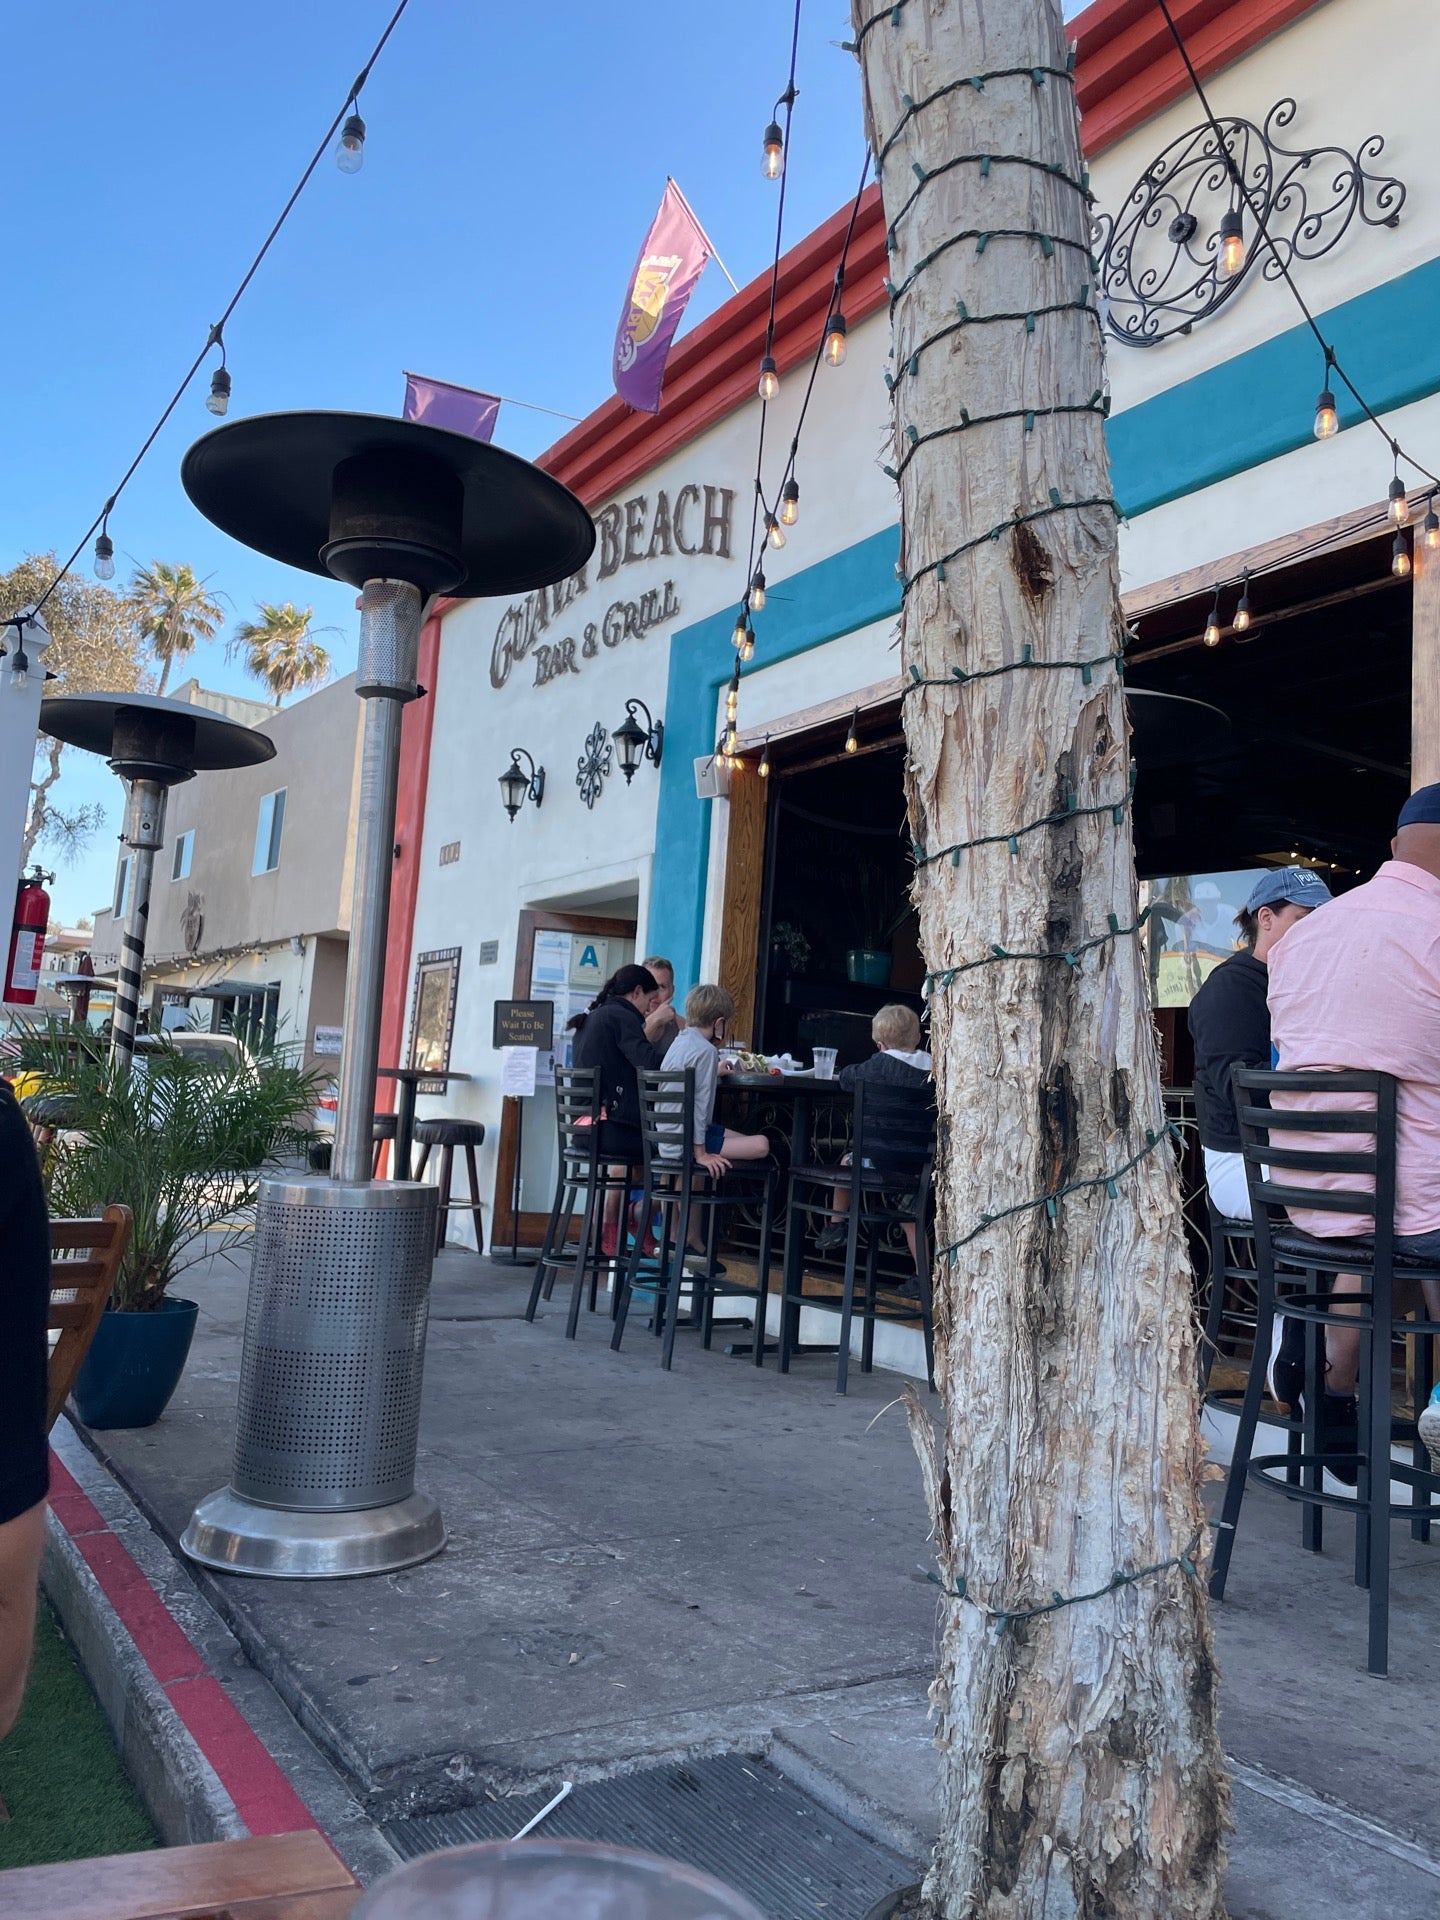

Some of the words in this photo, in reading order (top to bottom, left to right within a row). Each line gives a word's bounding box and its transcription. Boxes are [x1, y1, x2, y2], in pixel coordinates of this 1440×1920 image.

[592, 484, 733, 581] BEACH
[533, 638, 579, 688] BAR
[582, 622, 598, 658] &
[602, 579, 680, 647] GRILL
[579, 945, 598, 967] A
[510, 1009, 535, 1018] Please
[502, 1021, 519, 1029] Wait
[521, 1020, 532, 1029] To
[534, 1021, 545, 1030] Be
[508, 1032, 534, 1040] Seated
